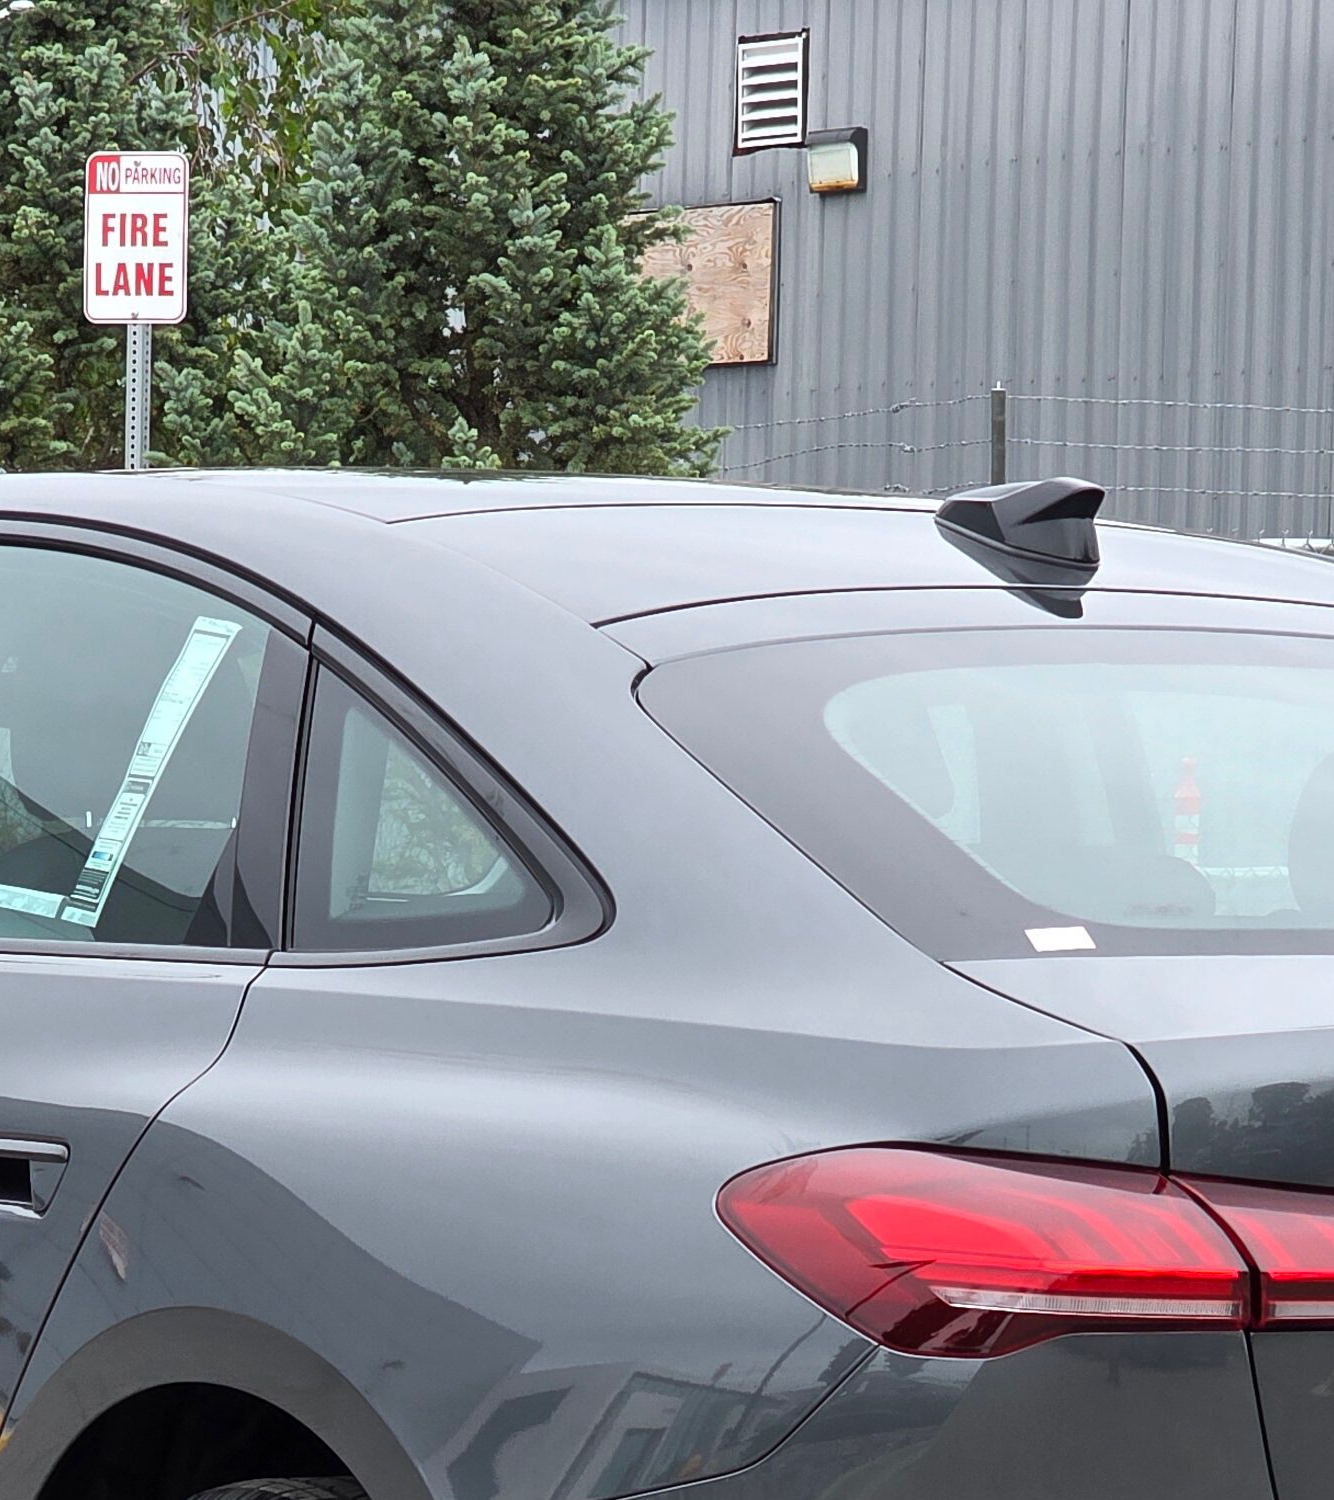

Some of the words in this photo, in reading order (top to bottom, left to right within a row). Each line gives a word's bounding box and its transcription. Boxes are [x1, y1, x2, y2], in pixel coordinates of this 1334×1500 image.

[95, 161, 120, 192] NO
[125, 167, 181, 185] PARKING
[102, 213, 169, 247] FIRE
[95, 262, 174, 296] LANE
